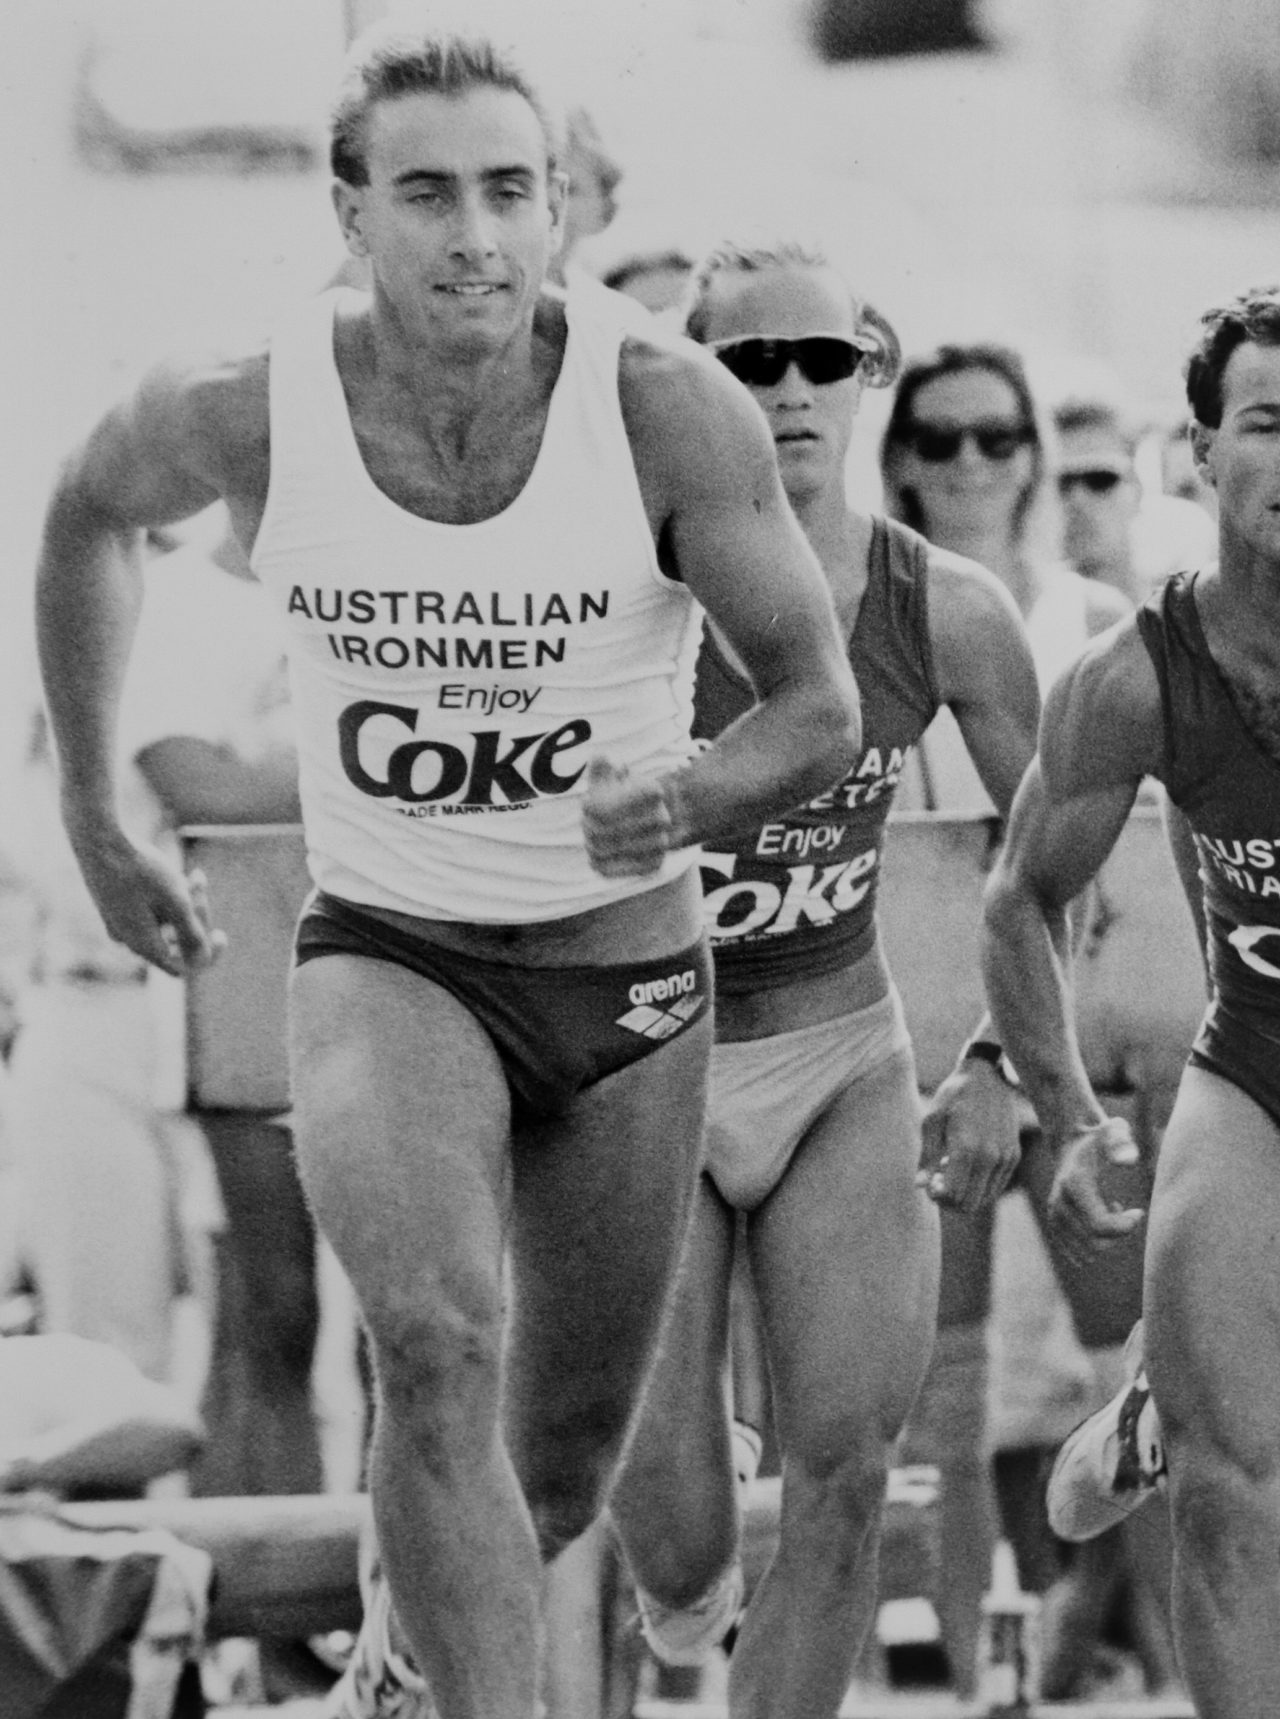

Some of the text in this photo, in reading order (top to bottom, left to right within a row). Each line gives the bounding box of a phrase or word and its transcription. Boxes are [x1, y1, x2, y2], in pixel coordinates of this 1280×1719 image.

[287, 584, 610, 627] AUSTRALIAN
[327, 633, 567, 670] IRONMEN
[437, 683, 542, 716] Enjoy
[337, 699, 592, 806] Coke
[755, 823, 847, 858] Enjoy
[628, 969, 696, 1006] arena
